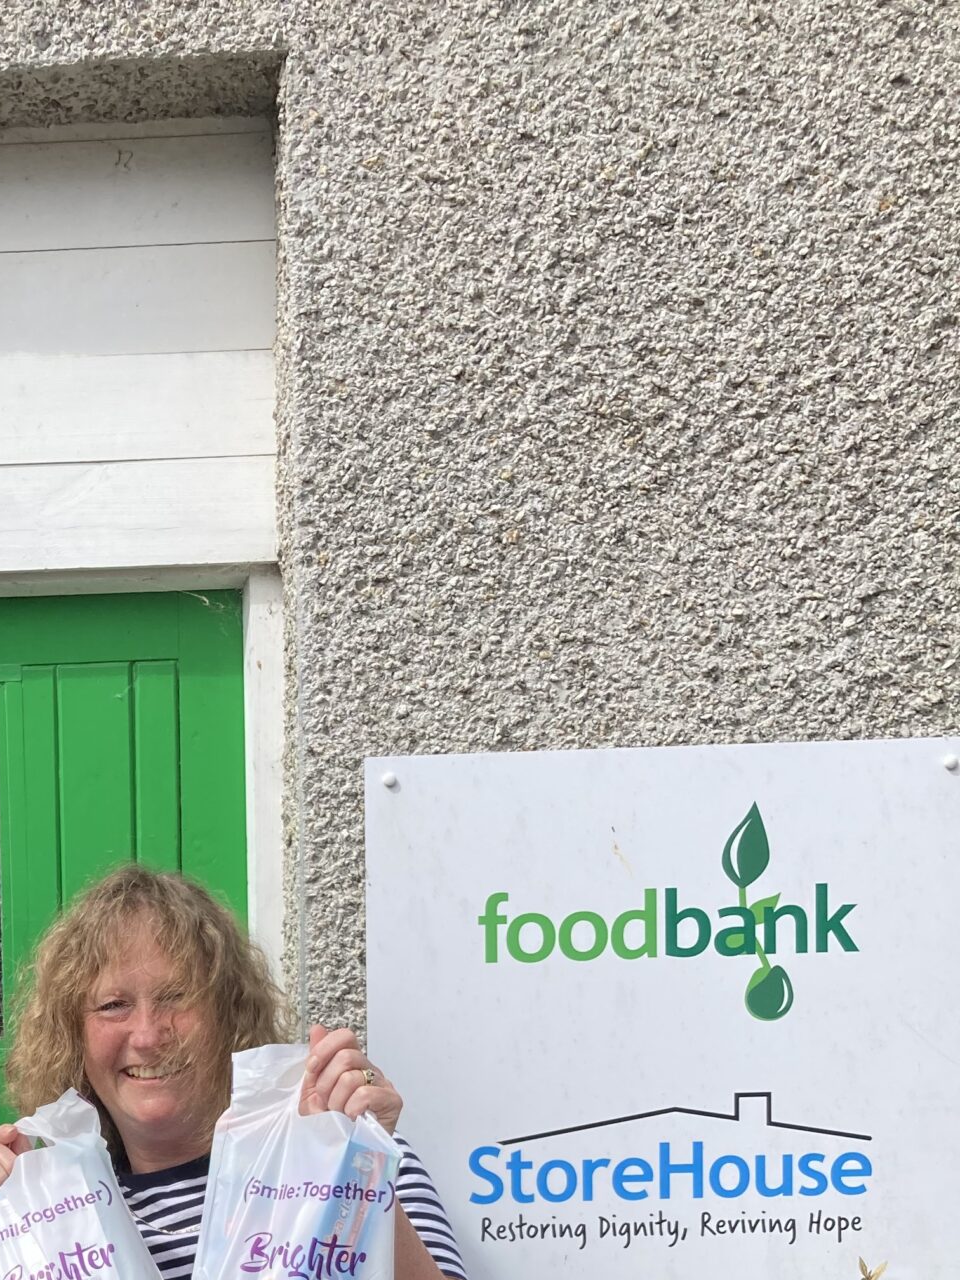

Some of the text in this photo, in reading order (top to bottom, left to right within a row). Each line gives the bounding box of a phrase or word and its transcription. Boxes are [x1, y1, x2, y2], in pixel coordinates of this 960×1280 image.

[479, 883, 859, 963] foodbank
[469, 1141, 873, 1205] StoreHouse
[481, 1209, 862, 1250] Restoring Dignity, Reviving Hope
